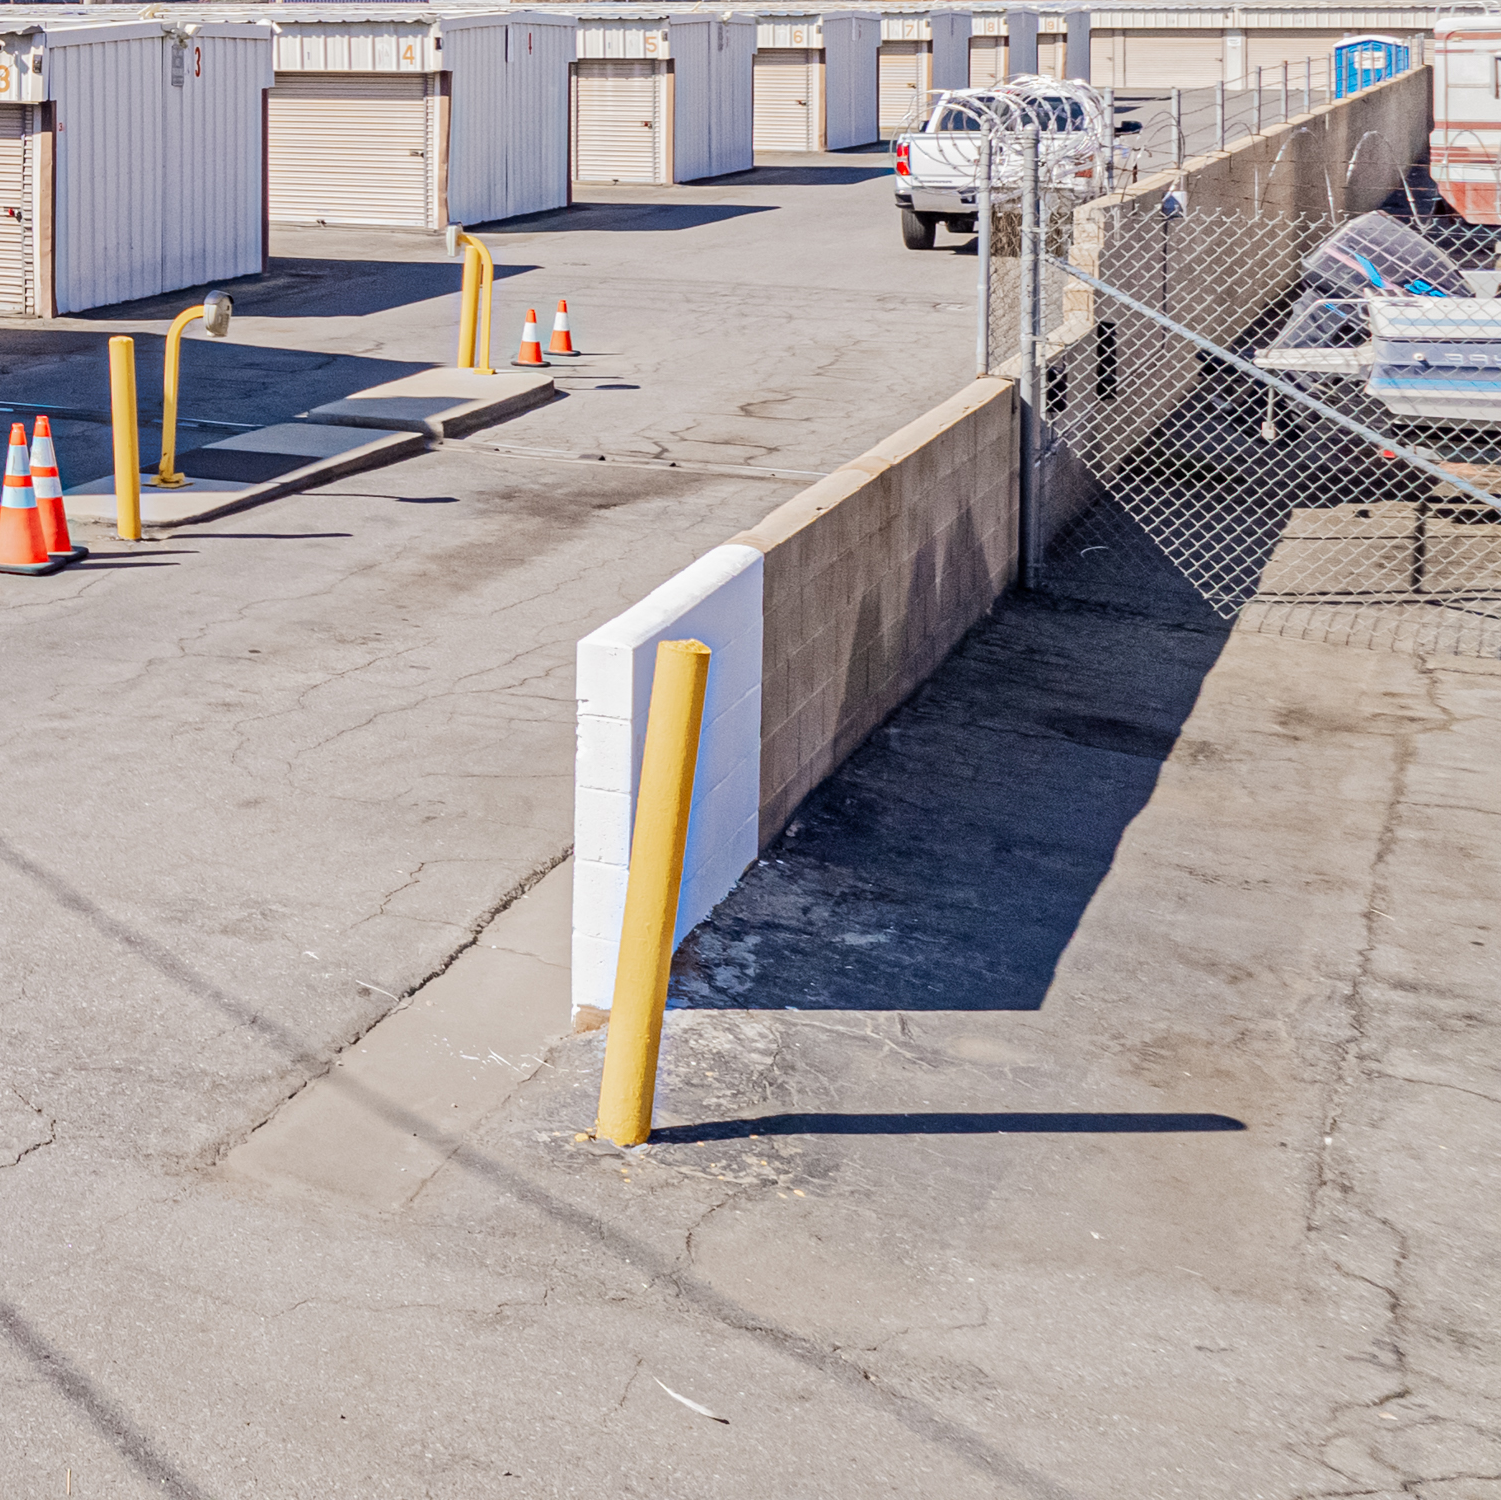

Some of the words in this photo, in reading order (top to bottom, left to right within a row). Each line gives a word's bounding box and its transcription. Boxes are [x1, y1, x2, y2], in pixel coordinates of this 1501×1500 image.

[905, 24, 914, 37] 7
[987, 21, 994, 32] 8
[793, 30, 803, 43] 6
[645, 36, 657, 53] 5
[194, 46, 201, 78] 3
[402, 44, 415, 65] 4
